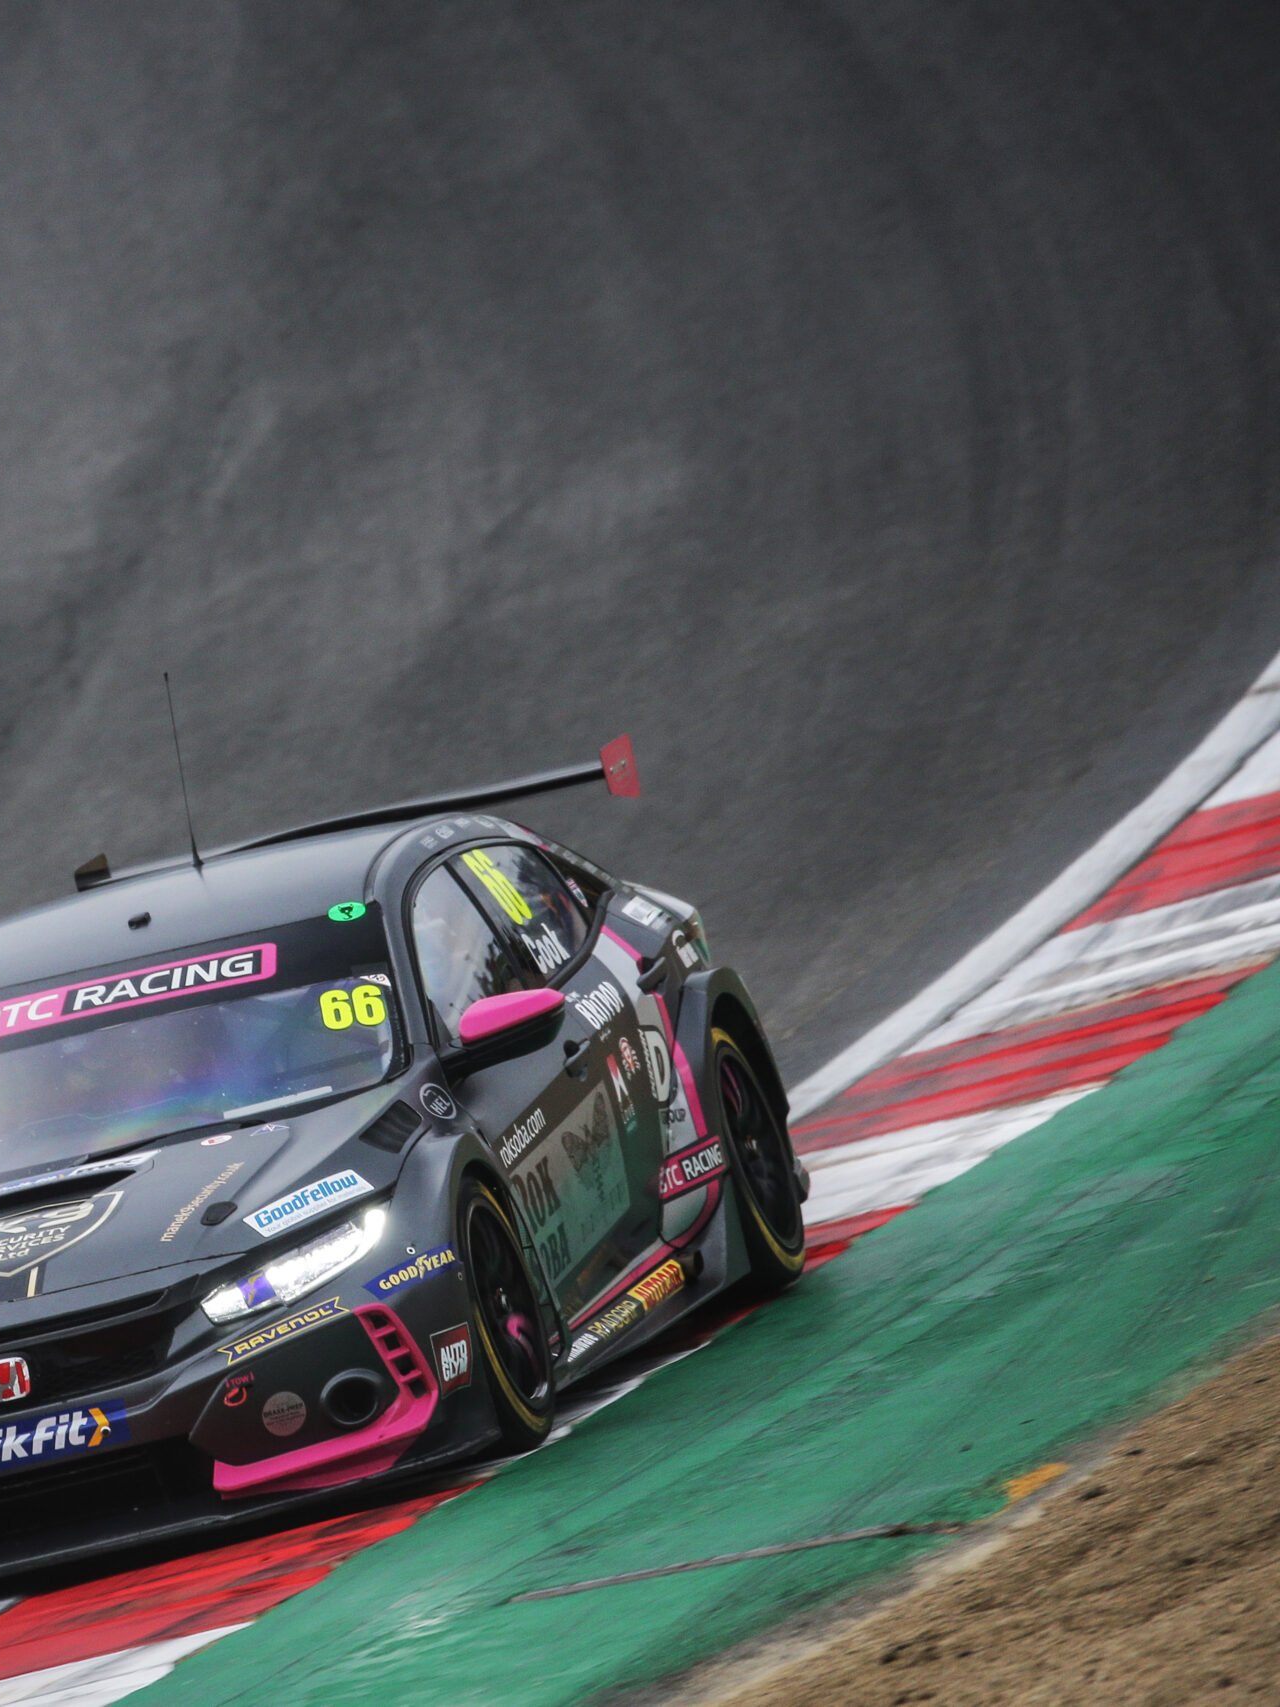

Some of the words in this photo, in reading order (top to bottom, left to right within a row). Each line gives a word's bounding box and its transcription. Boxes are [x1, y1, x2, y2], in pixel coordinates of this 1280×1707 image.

[521, 922, 570, 974] Cook
[72, 953, 254, 1011] RACING
[320, 984, 386, 1030] 66
[499, 1108, 547, 1168] roksoba.com
[681, 1144, 723, 1182] RACING
[379, 1249, 455, 1290] GOODYEAR
[233, 1305, 333, 1355] RAVENOL
[440, 1339, 467, 1365] AUTO
